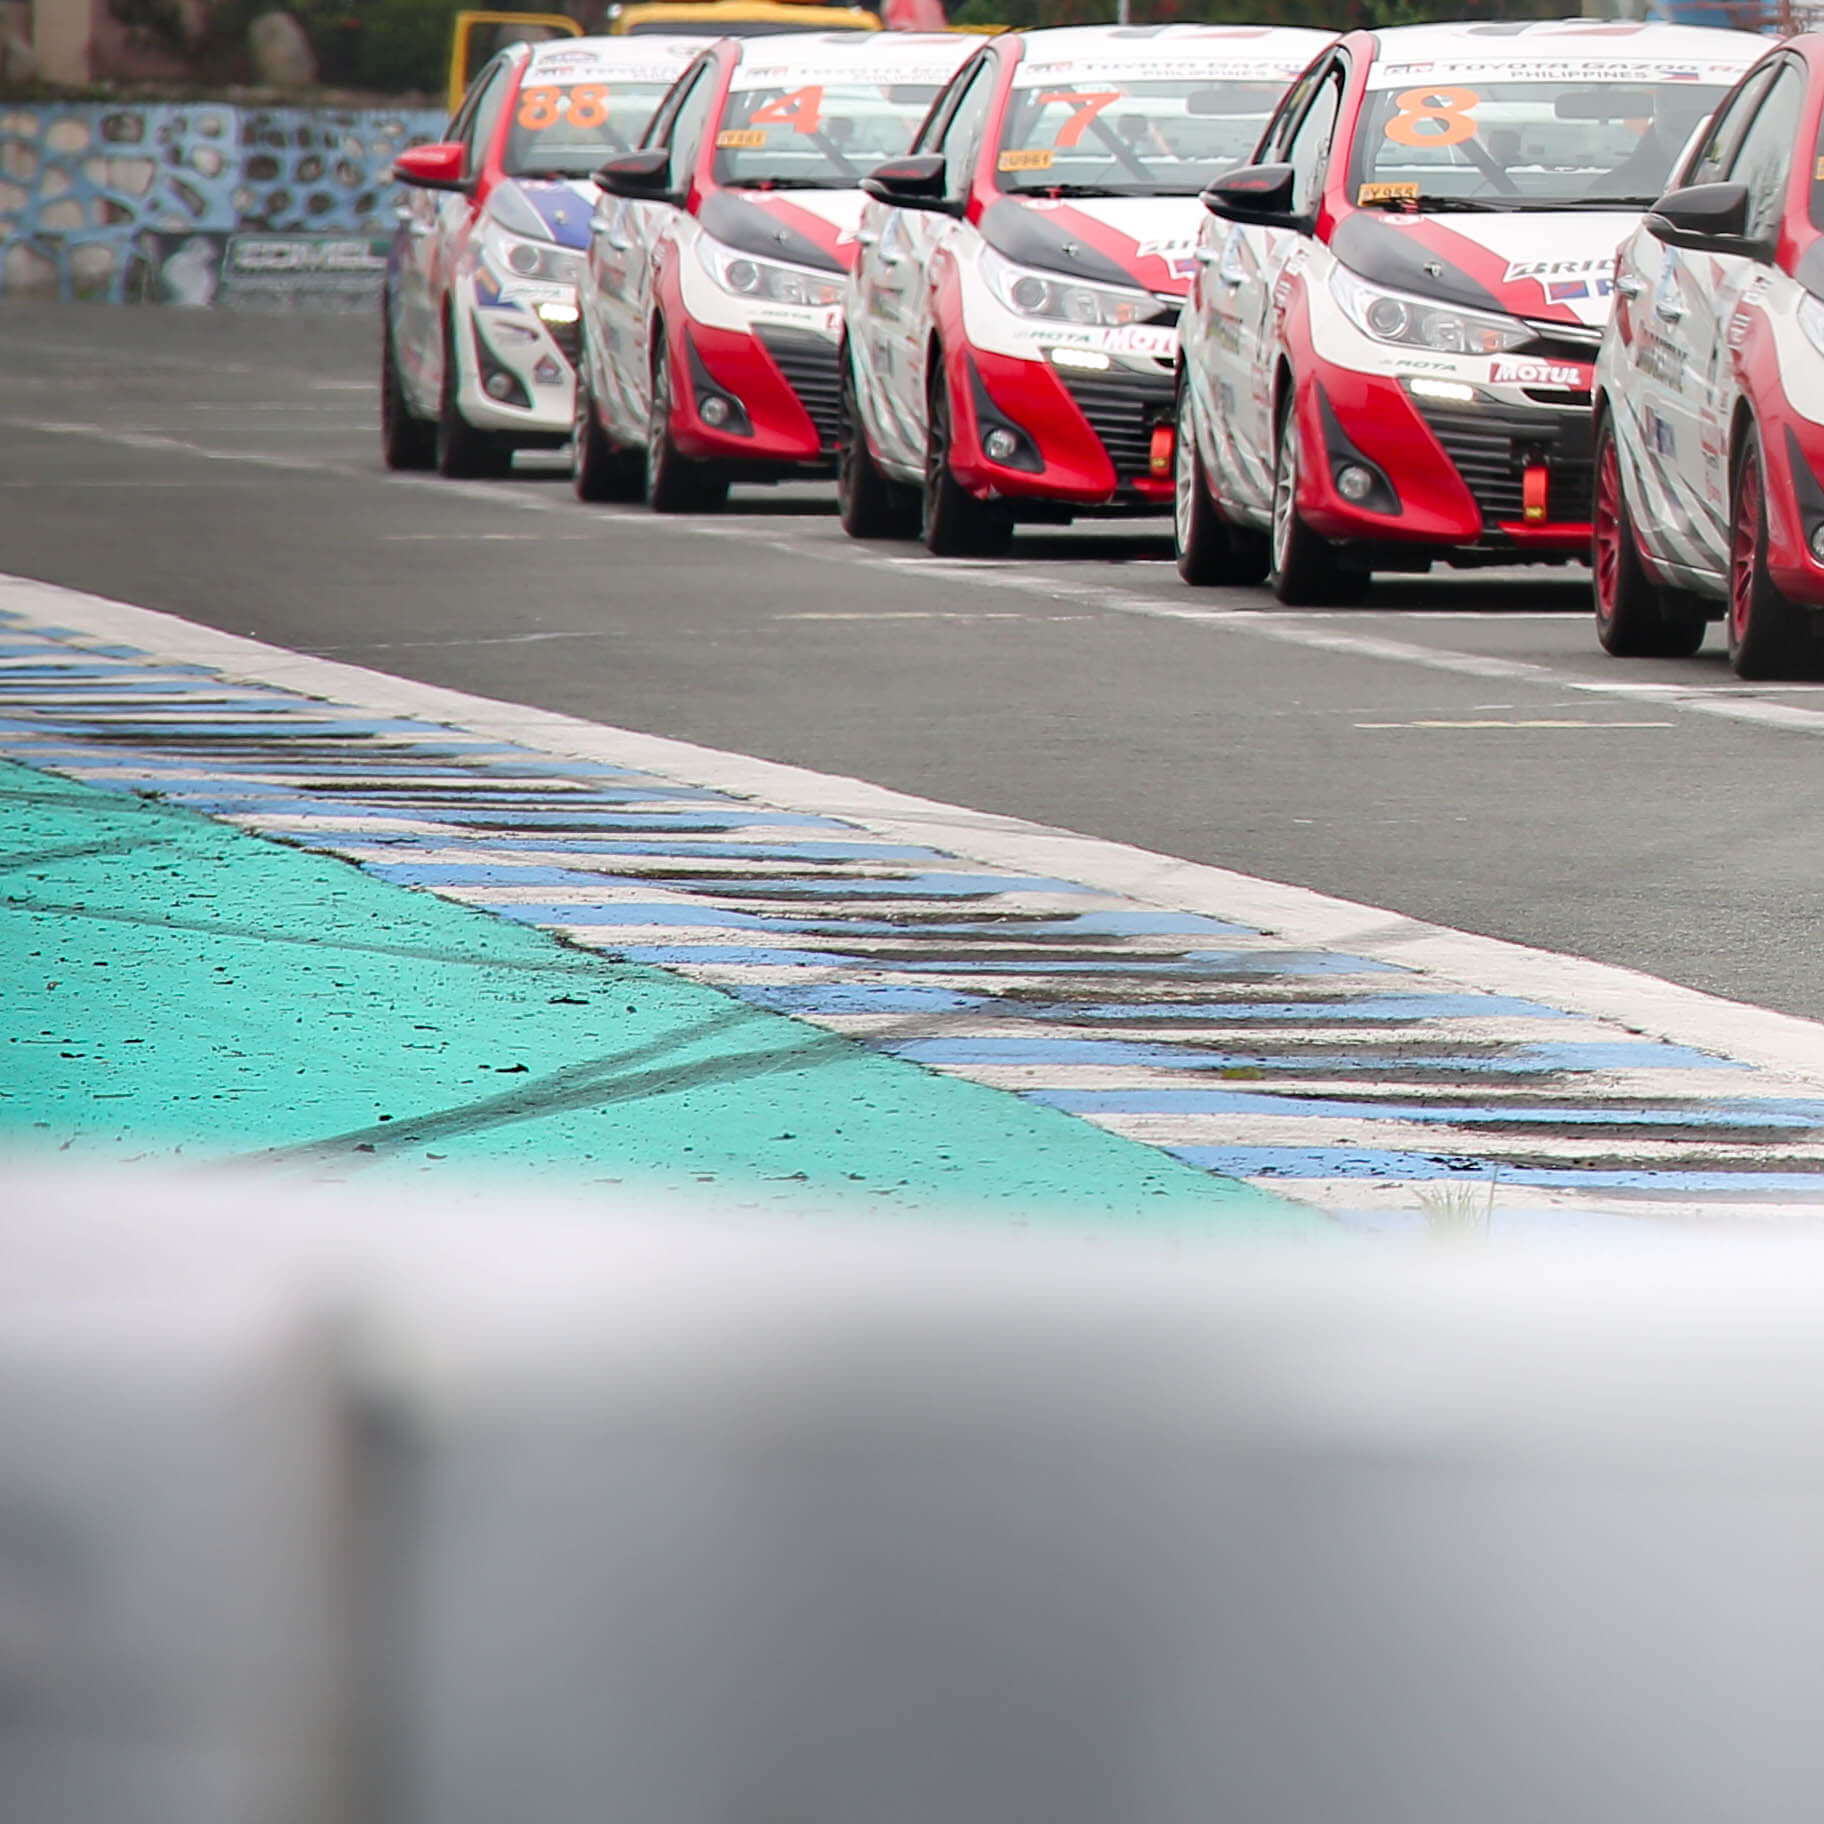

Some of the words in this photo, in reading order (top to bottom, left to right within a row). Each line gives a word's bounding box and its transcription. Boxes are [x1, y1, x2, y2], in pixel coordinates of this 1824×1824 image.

[517, 83, 610, 131] 88
[751, 84, 824, 135] 4
[1039, 91, 1122, 149] 7
[1385, 86, 1481, 148] 8
[1102, 328, 1178, 355] MOT
[1494, 364, 1581, 386] MOTUL
